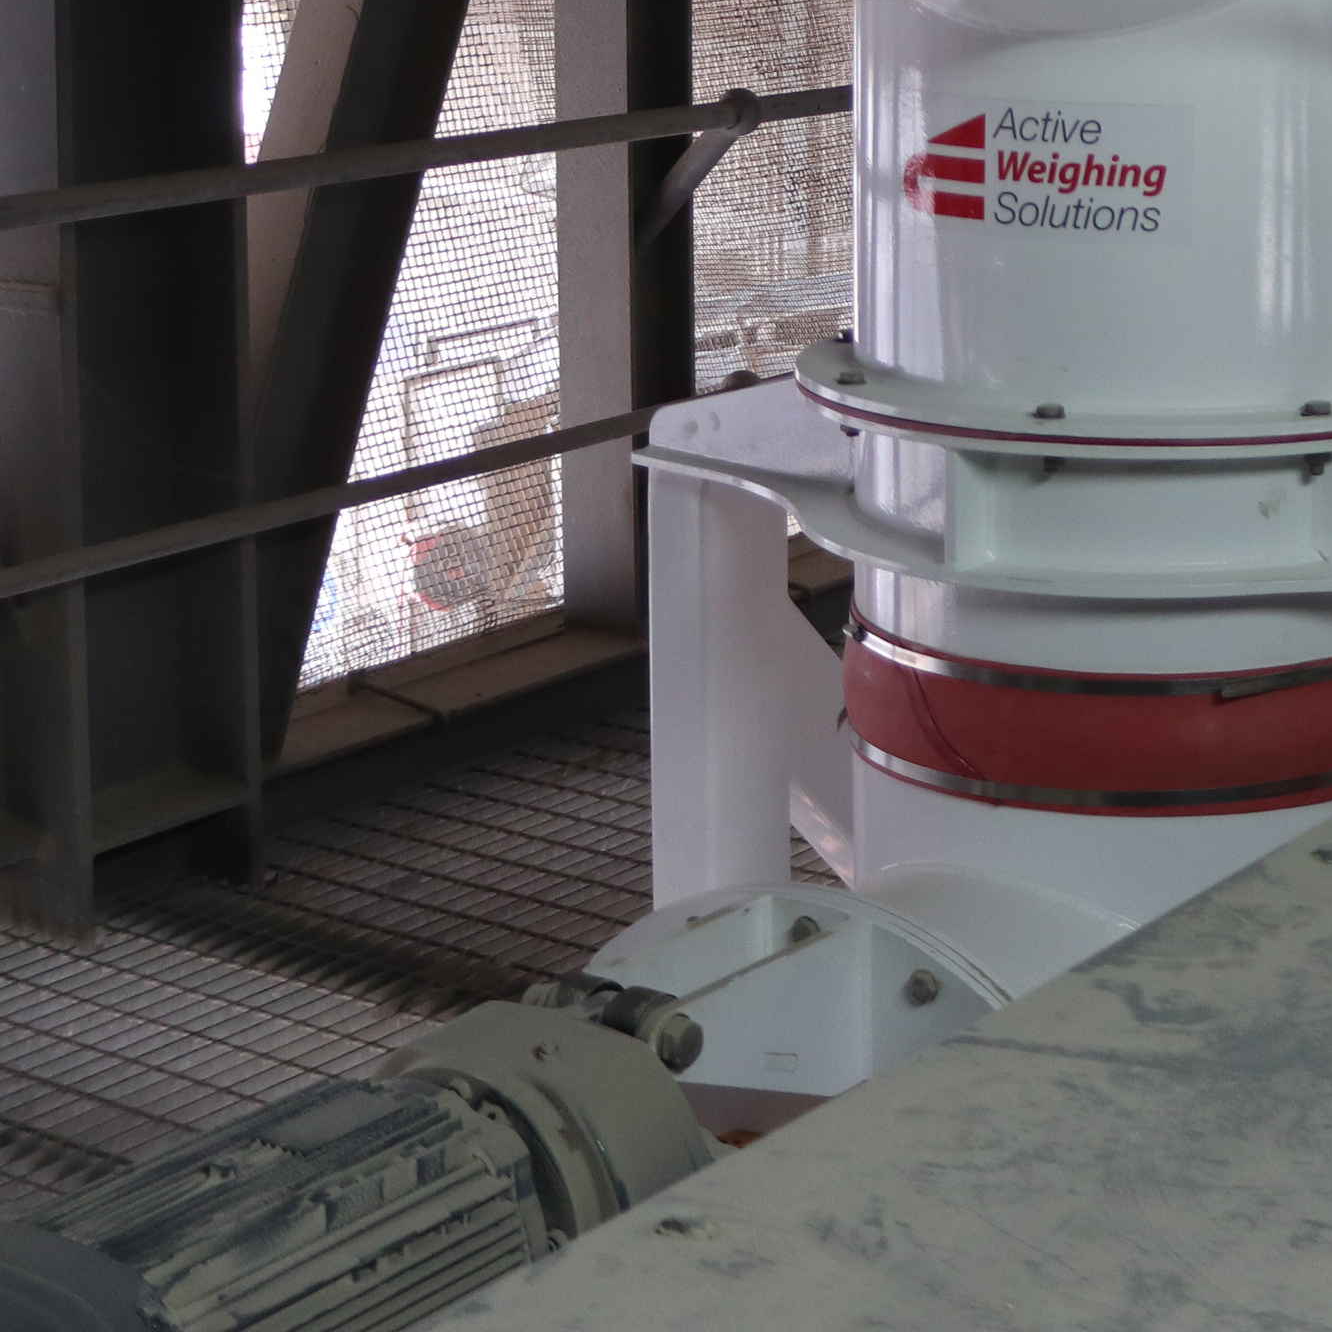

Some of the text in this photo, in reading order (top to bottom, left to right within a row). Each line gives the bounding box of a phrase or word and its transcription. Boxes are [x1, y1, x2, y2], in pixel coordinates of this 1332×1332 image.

[993, 107, 1102, 145] Active
[997, 150, 1167, 197] Weighing
[993, 191, 1161, 232] Solutions
